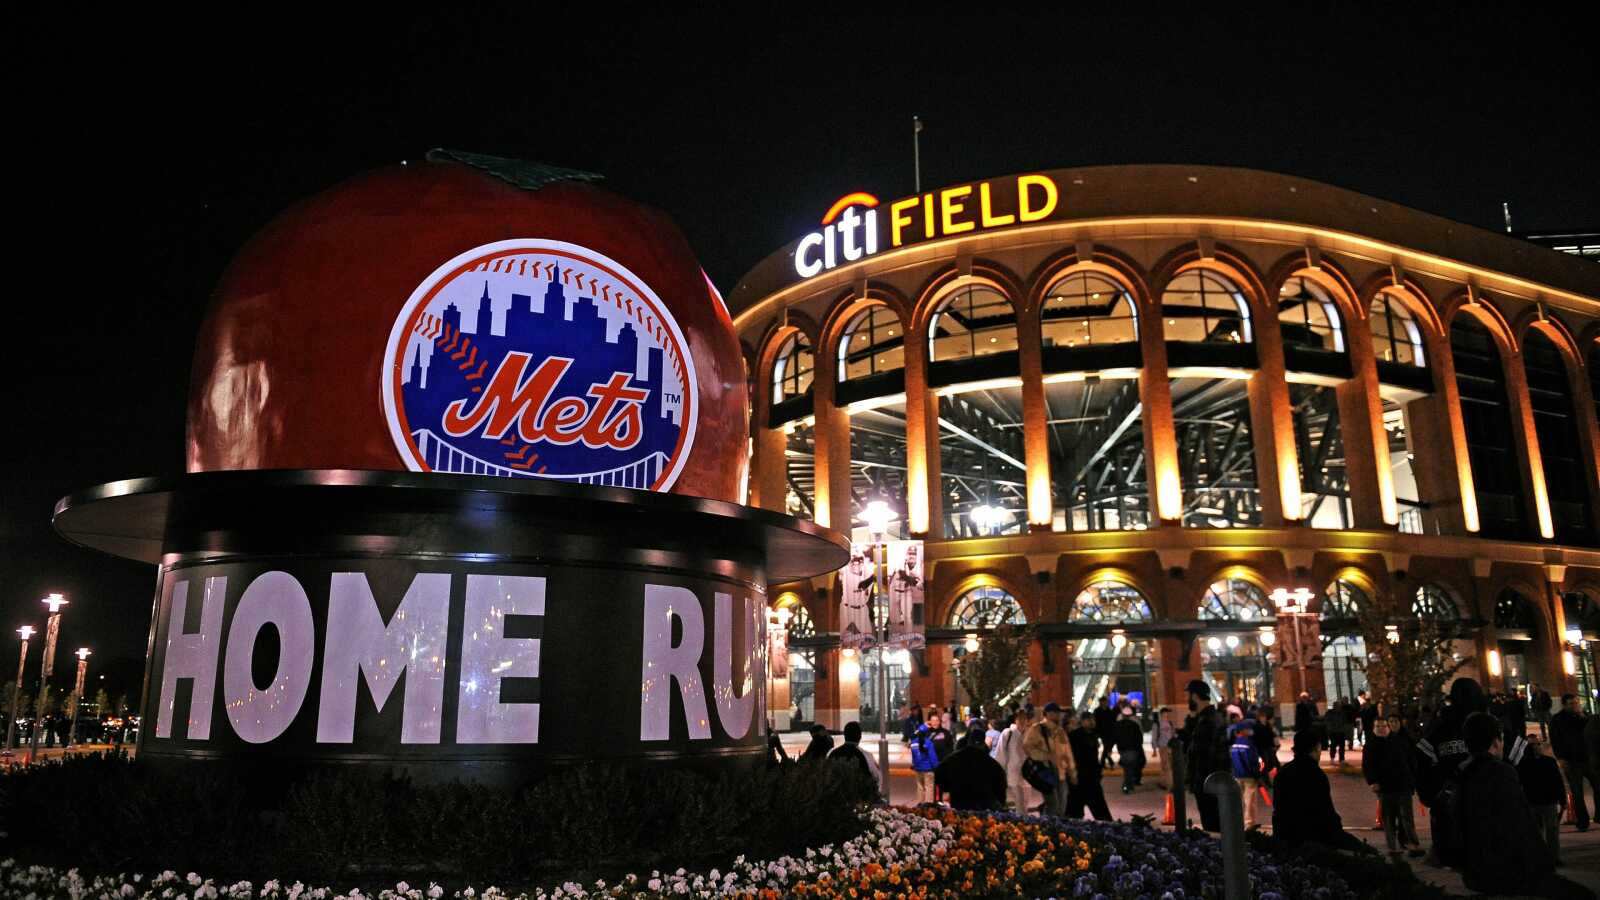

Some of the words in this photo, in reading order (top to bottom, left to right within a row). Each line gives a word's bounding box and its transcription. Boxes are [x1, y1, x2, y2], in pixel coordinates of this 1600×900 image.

[795, 205, 877, 278] citi
[891, 175, 1058, 247] FIELD
[442, 350, 650, 450] Mets
[664, 392, 681, 404] TM
[155, 570, 547, 745] HOME
[640, 584, 765, 741] RU
